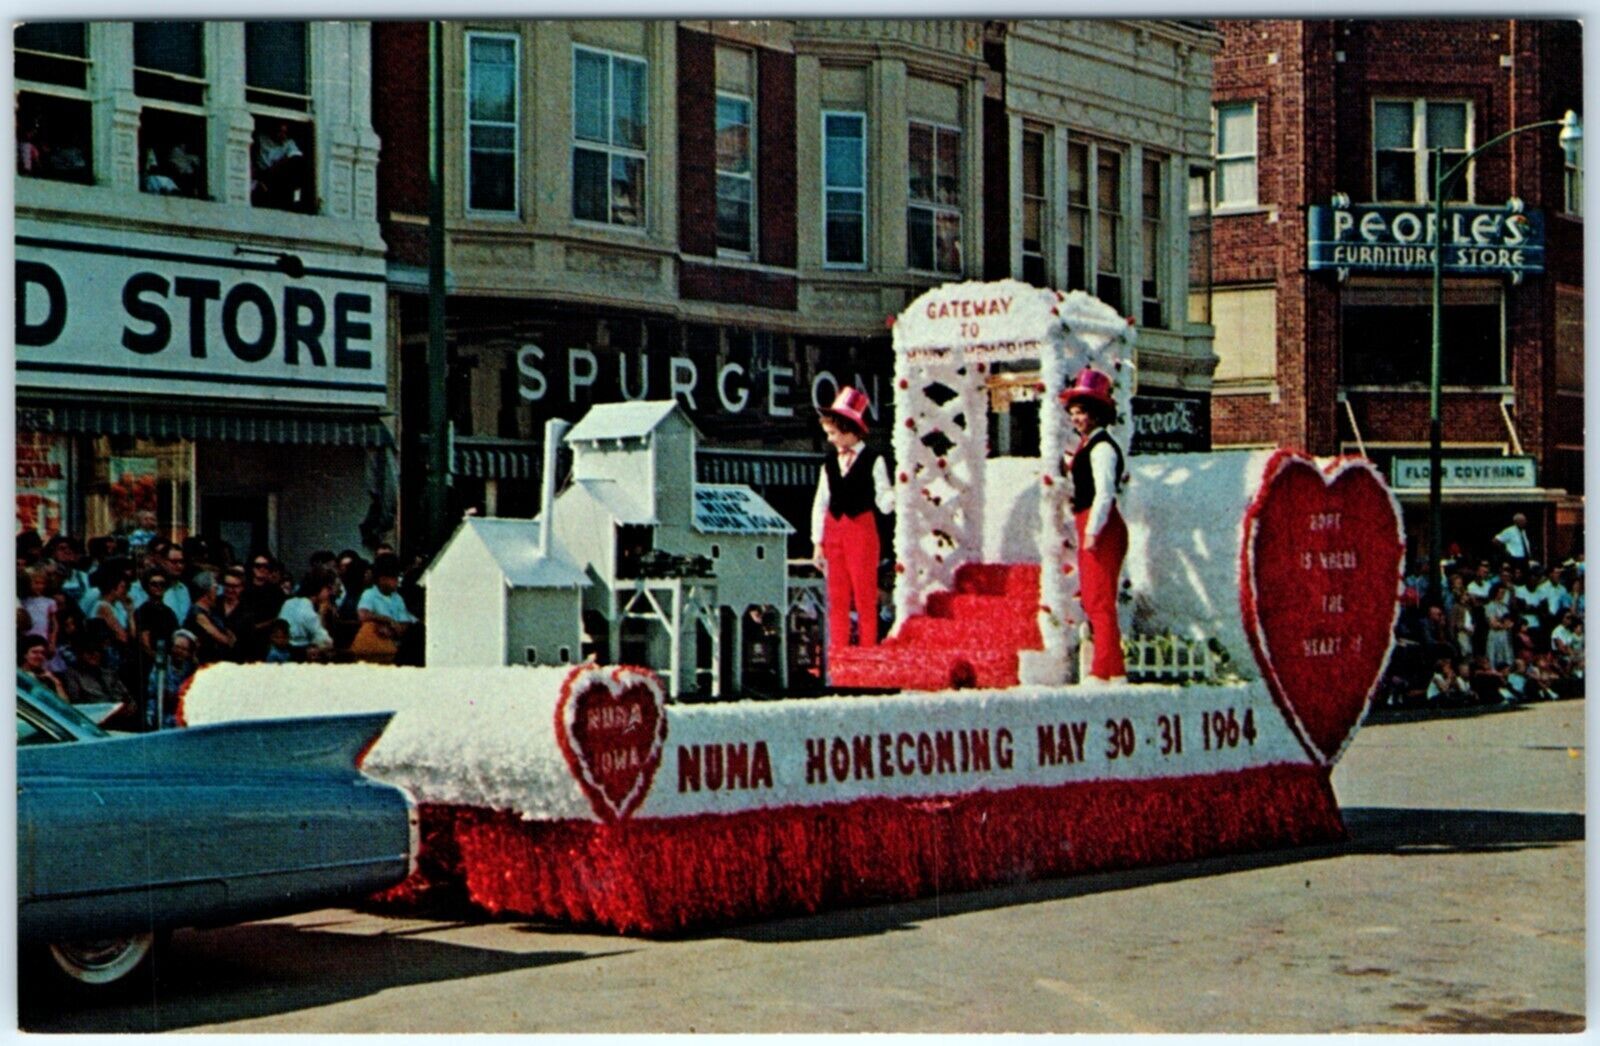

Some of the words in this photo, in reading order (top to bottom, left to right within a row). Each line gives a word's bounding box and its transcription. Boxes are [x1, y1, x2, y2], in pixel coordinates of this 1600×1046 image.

[1333, 210, 1530, 246] PEOPLE'S
[1457, 249, 1525, 267] STORE
[926, 296, 1013, 319] GATEWAY
[121, 271, 372, 370] STORE
[961, 322, 980, 338] TO
[1405, 465, 1448, 479] FLOR
[1454, 465, 1526, 479] COVERING
[677, 741, 774, 793] NUMA
[805, 727, 1014, 785] HOMECOMING
[1037, 722, 1088, 767] MAY
[1202, 708, 1258, 751] 1964
